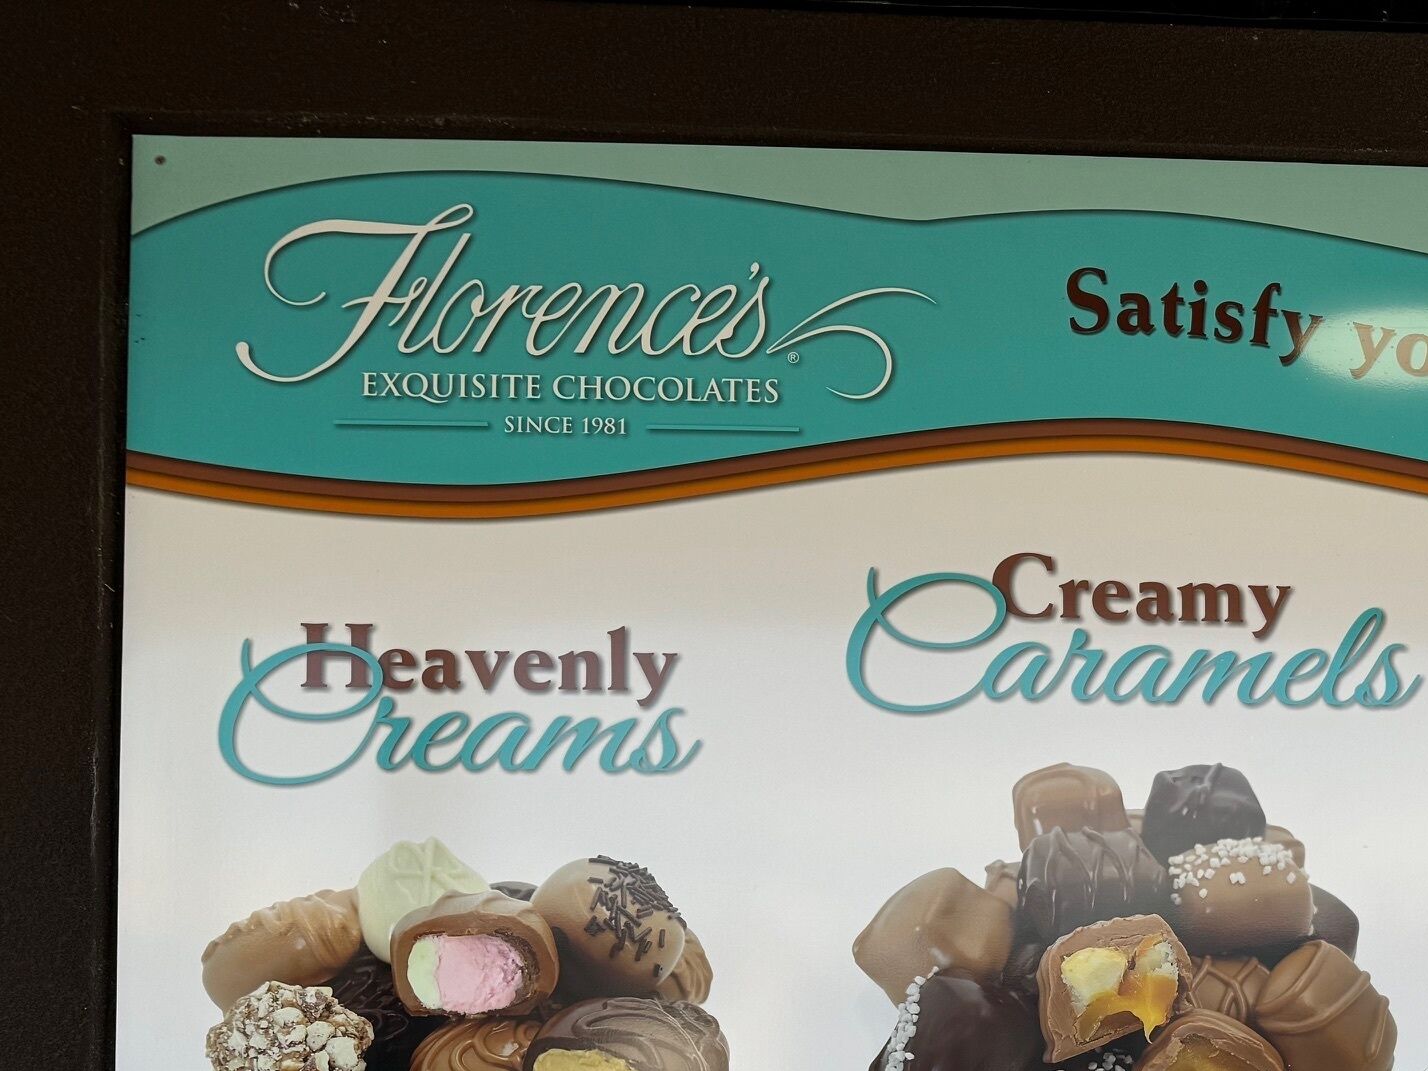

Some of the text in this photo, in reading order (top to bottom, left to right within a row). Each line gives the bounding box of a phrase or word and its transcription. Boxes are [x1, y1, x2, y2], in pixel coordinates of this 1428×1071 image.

[235, 203, 770, 382] Florence's
[1065, 267, 1323, 366] Satisfy
[361, 372, 780, 404] EXQUISITE CHOCOLATES
[504, 415, 627, 435] SINCE 1981
[845, 566, 1421, 714] Caramels
[991, 552, 1292, 639] Creamy
[300, 622, 678, 707] Heavenly
[218, 638, 701, 787] Creams
